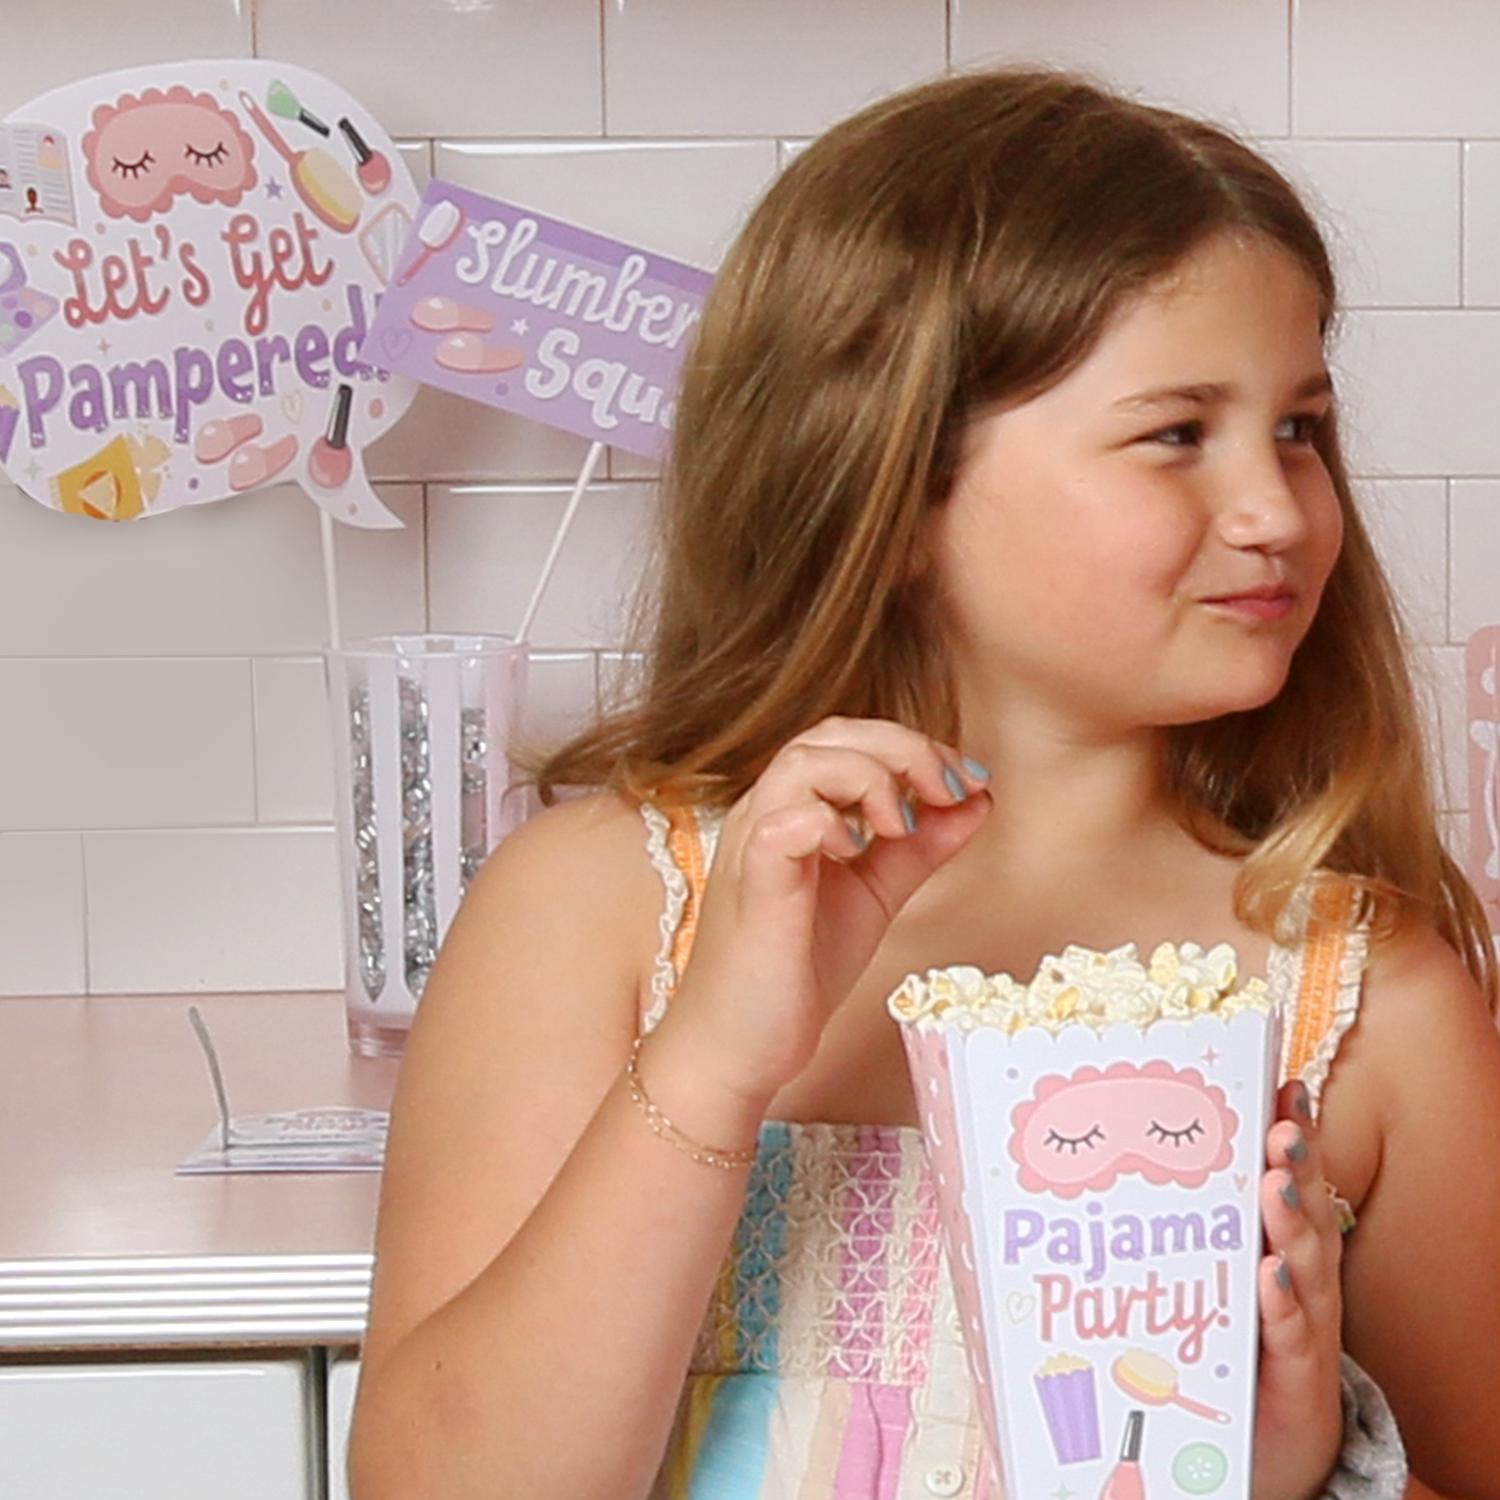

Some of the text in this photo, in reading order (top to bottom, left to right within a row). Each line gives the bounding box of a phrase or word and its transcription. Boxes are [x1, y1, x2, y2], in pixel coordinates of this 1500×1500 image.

[53, 212, 334, 336] Let's Get
[455, 217, 702, 350] Slumber
[1003, 1200, 1244, 1283] Pajama
[1033, 1260, 1231, 1365] Party!
